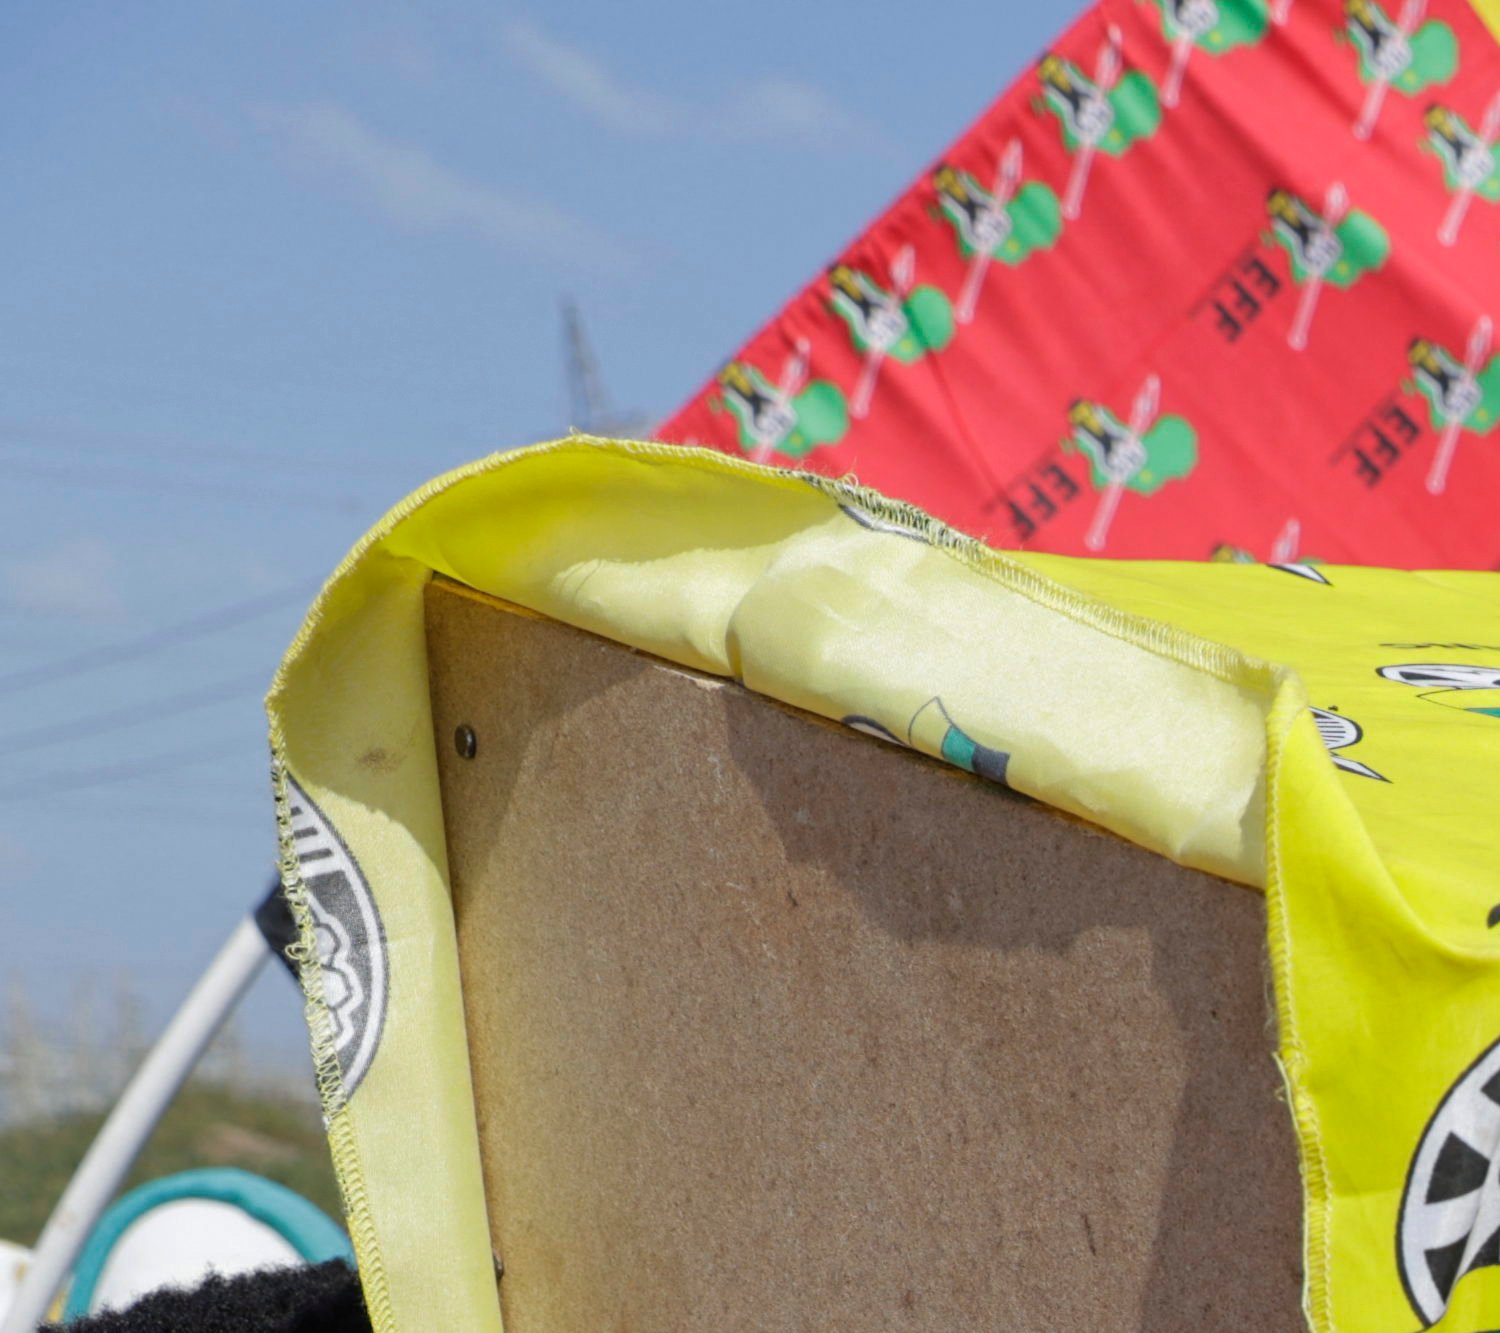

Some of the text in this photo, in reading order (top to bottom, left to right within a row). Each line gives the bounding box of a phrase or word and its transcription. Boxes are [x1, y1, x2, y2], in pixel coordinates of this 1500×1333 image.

[1212, 257, 1281, 344] EFF
[1353, 405, 1420, 488] EFF
[1007, 463, 1079, 542] EFF
